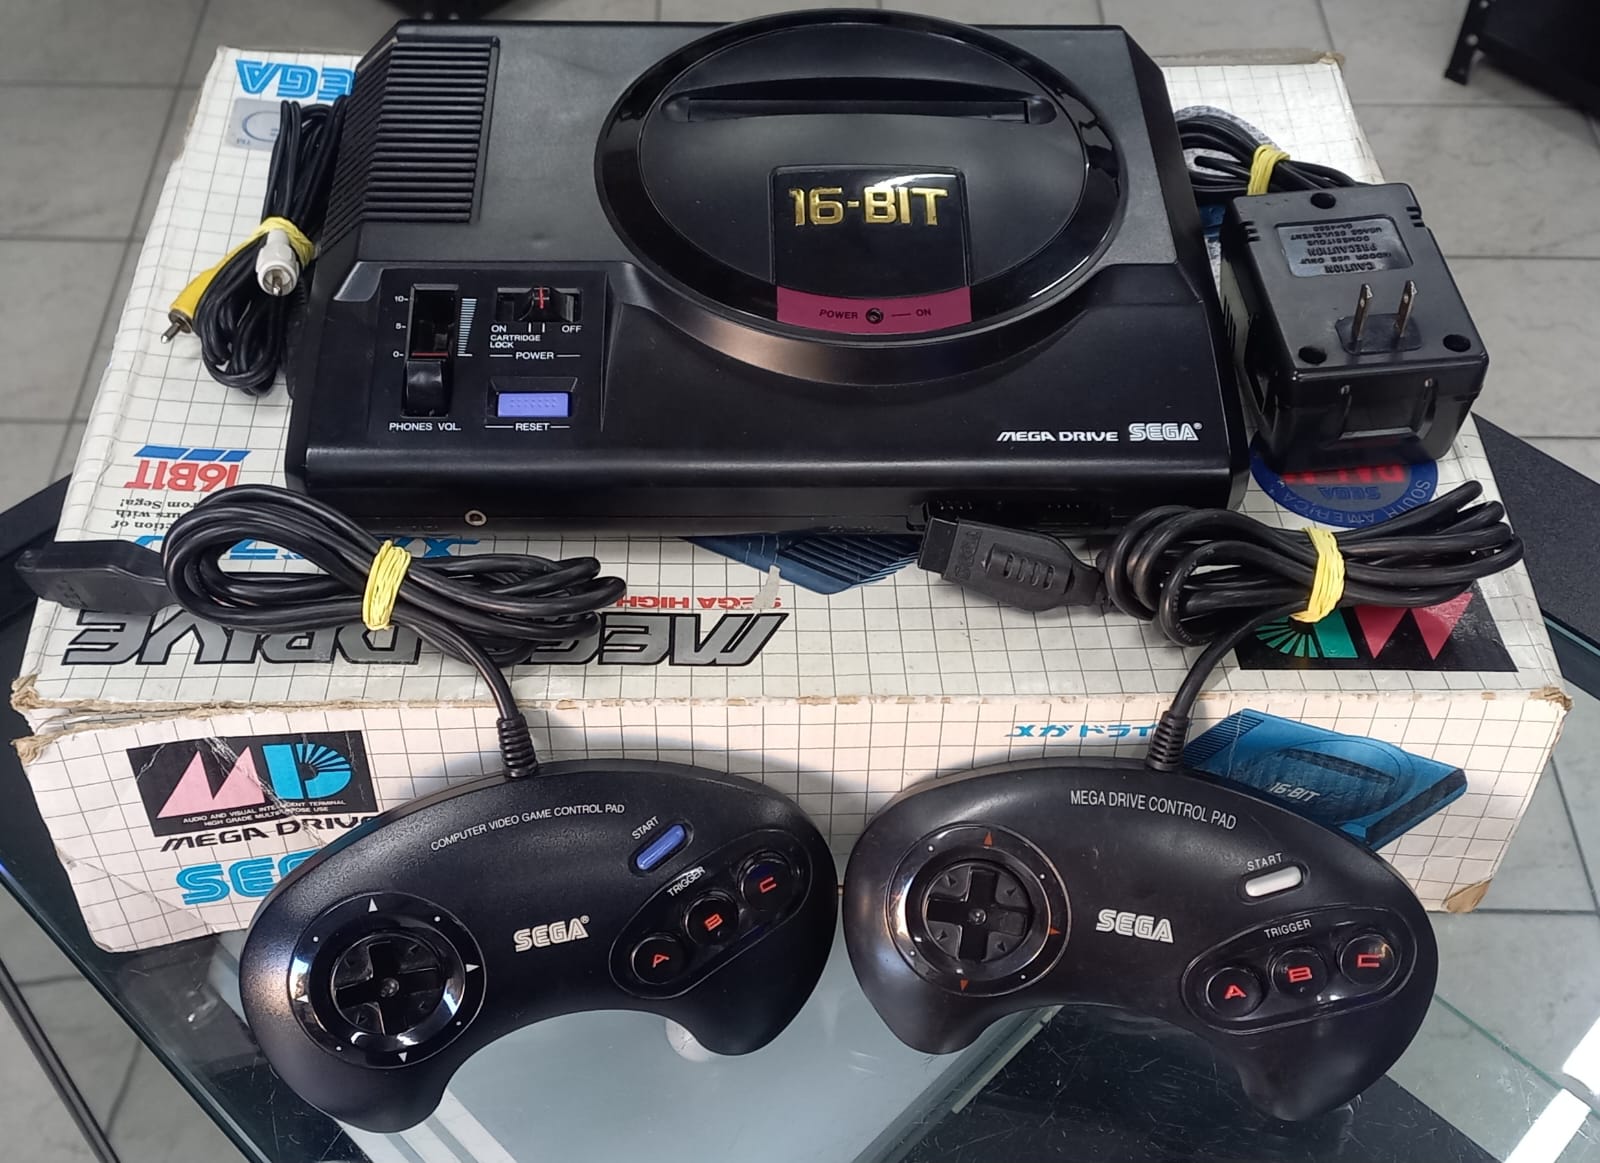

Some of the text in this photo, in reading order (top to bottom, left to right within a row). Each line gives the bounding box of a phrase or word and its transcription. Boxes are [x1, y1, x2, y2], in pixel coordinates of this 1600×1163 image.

[236, 59, 356, 101] EGA
[789, 186, 949, 227] 16-BIT
[1307, 243, 1377, 256] PRECAUTION
[1325, 262, 1375, 274] CAUTION
[819, 308, 859, 320] POWER
[916, 308, 932, 317] ON
[491, 324, 507, 333] ON
[562, 324, 582, 333] OFF
[490, 334, 541, 342] CARTRIDGE
[515, 351, 554, 360] POWER
[389, 422, 462, 431] PHONES VOL.
[515, 422, 550, 431] RESET
[996, 431, 1119, 442] MEGA DRIVE
[120, 498, 163, 509] Sega!
[1384, 479, 1431, 519] SOUTH
[115, 509, 150, 519] with
[111, 519, 129, 529] of
[1269, 781, 1321, 803] 16-BIT
[183, 815, 208, 824] AUDIO
[229, 808, 257, 817] VISUAL
[1070, 789, 1238, 831] MEGA DRIVE CONTROL PAD
[204, 819, 224, 827] HIGH
[225, 815, 253, 824] GRADE
[430, 803, 626, 851] COMPUTER VIDEO GAME CONTROL PAD
[631, 816, 660, 841] START
[161, 827, 268, 852] MEGA
[1247, 852, 1284, 873] START
[666, 866, 706, 898] TRIGGER
[652, 876, 777, 969] A B C
[1095, 908, 1174, 944] SEGA
[1264, 918, 1312, 940] TRIGGER
[1223, 953, 1380, 1000] A B C
